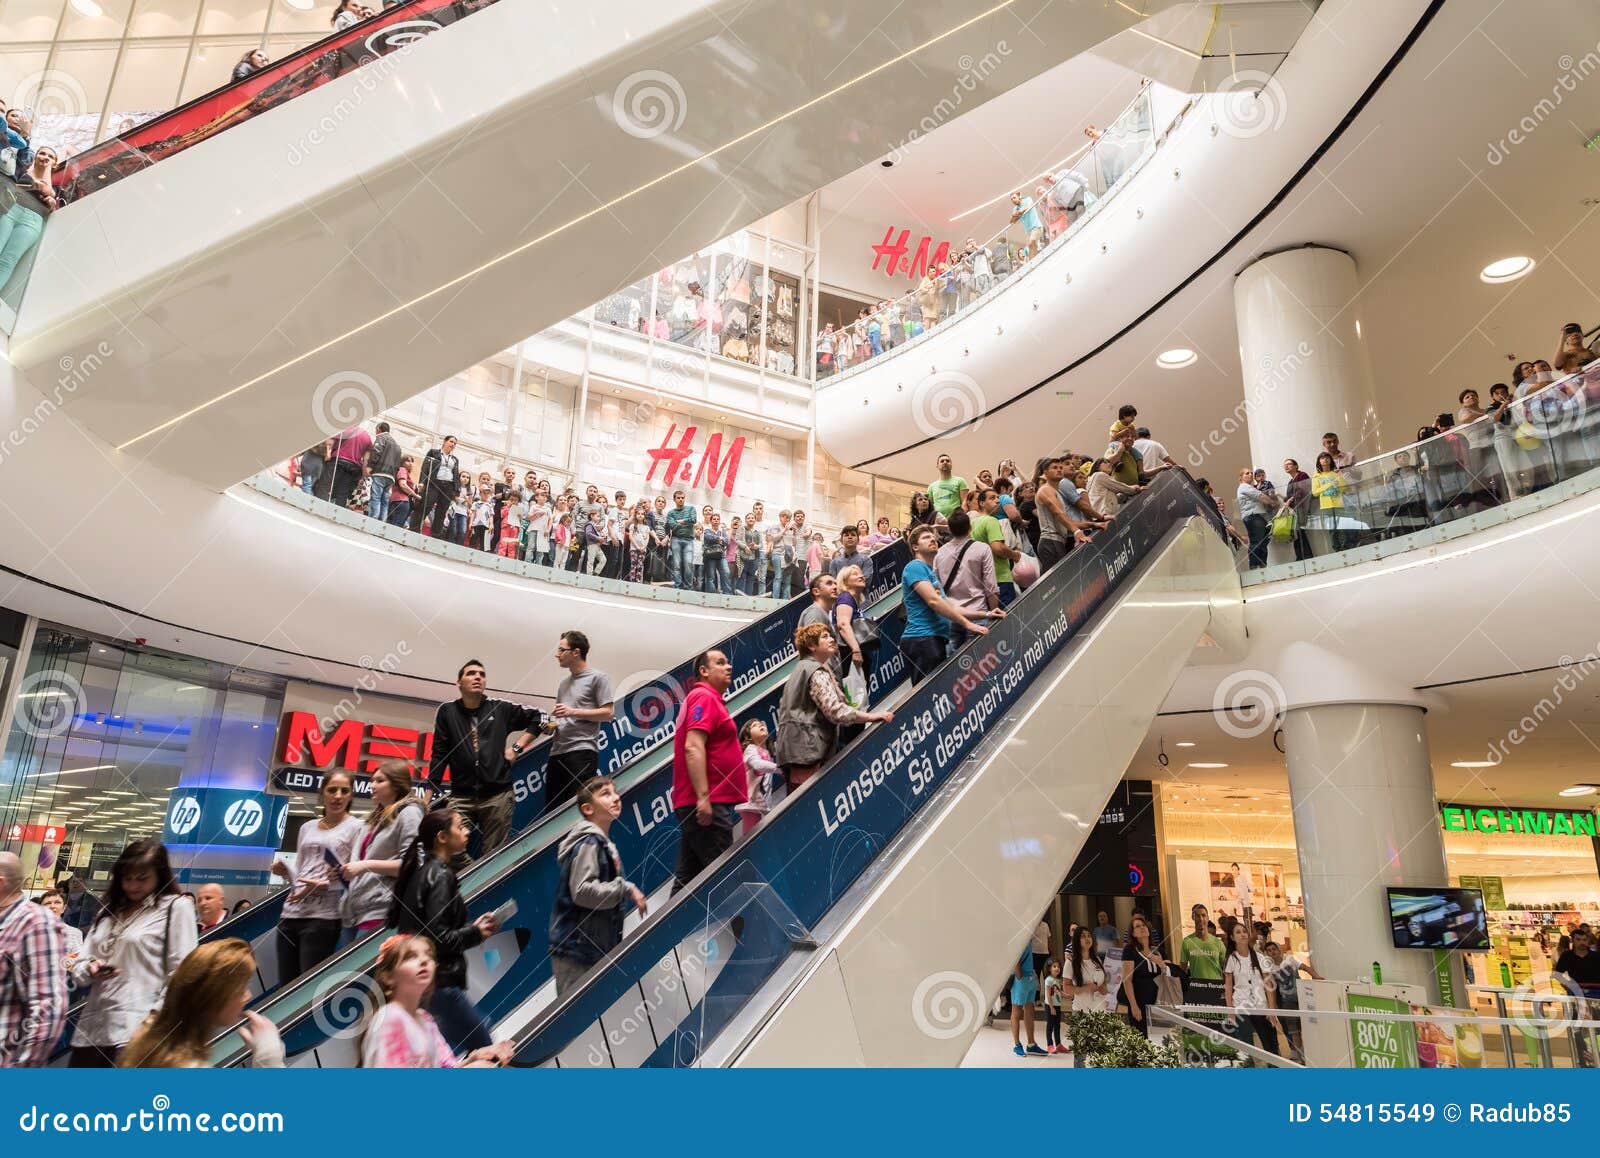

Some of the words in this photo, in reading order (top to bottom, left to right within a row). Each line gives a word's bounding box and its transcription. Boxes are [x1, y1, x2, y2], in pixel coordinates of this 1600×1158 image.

[871, 225, 950, 279] H&M
[646, 423, 746, 497] H&M
[908, 751, 934, 796] Să
[935, 676, 1003, 768] descoperi
[1002, 660, 1024, 695] cea
[1023, 632, 1045, 672] mai
[1043, 609, 1068, 650] nouă
[285, 772, 314, 788] LED
[818, 709, 935, 837] Lansează-te
[171, 797, 200, 835] hp
[224, 799, 263, 836] hp
[1357, 1020, 1398, 1054] 80%
